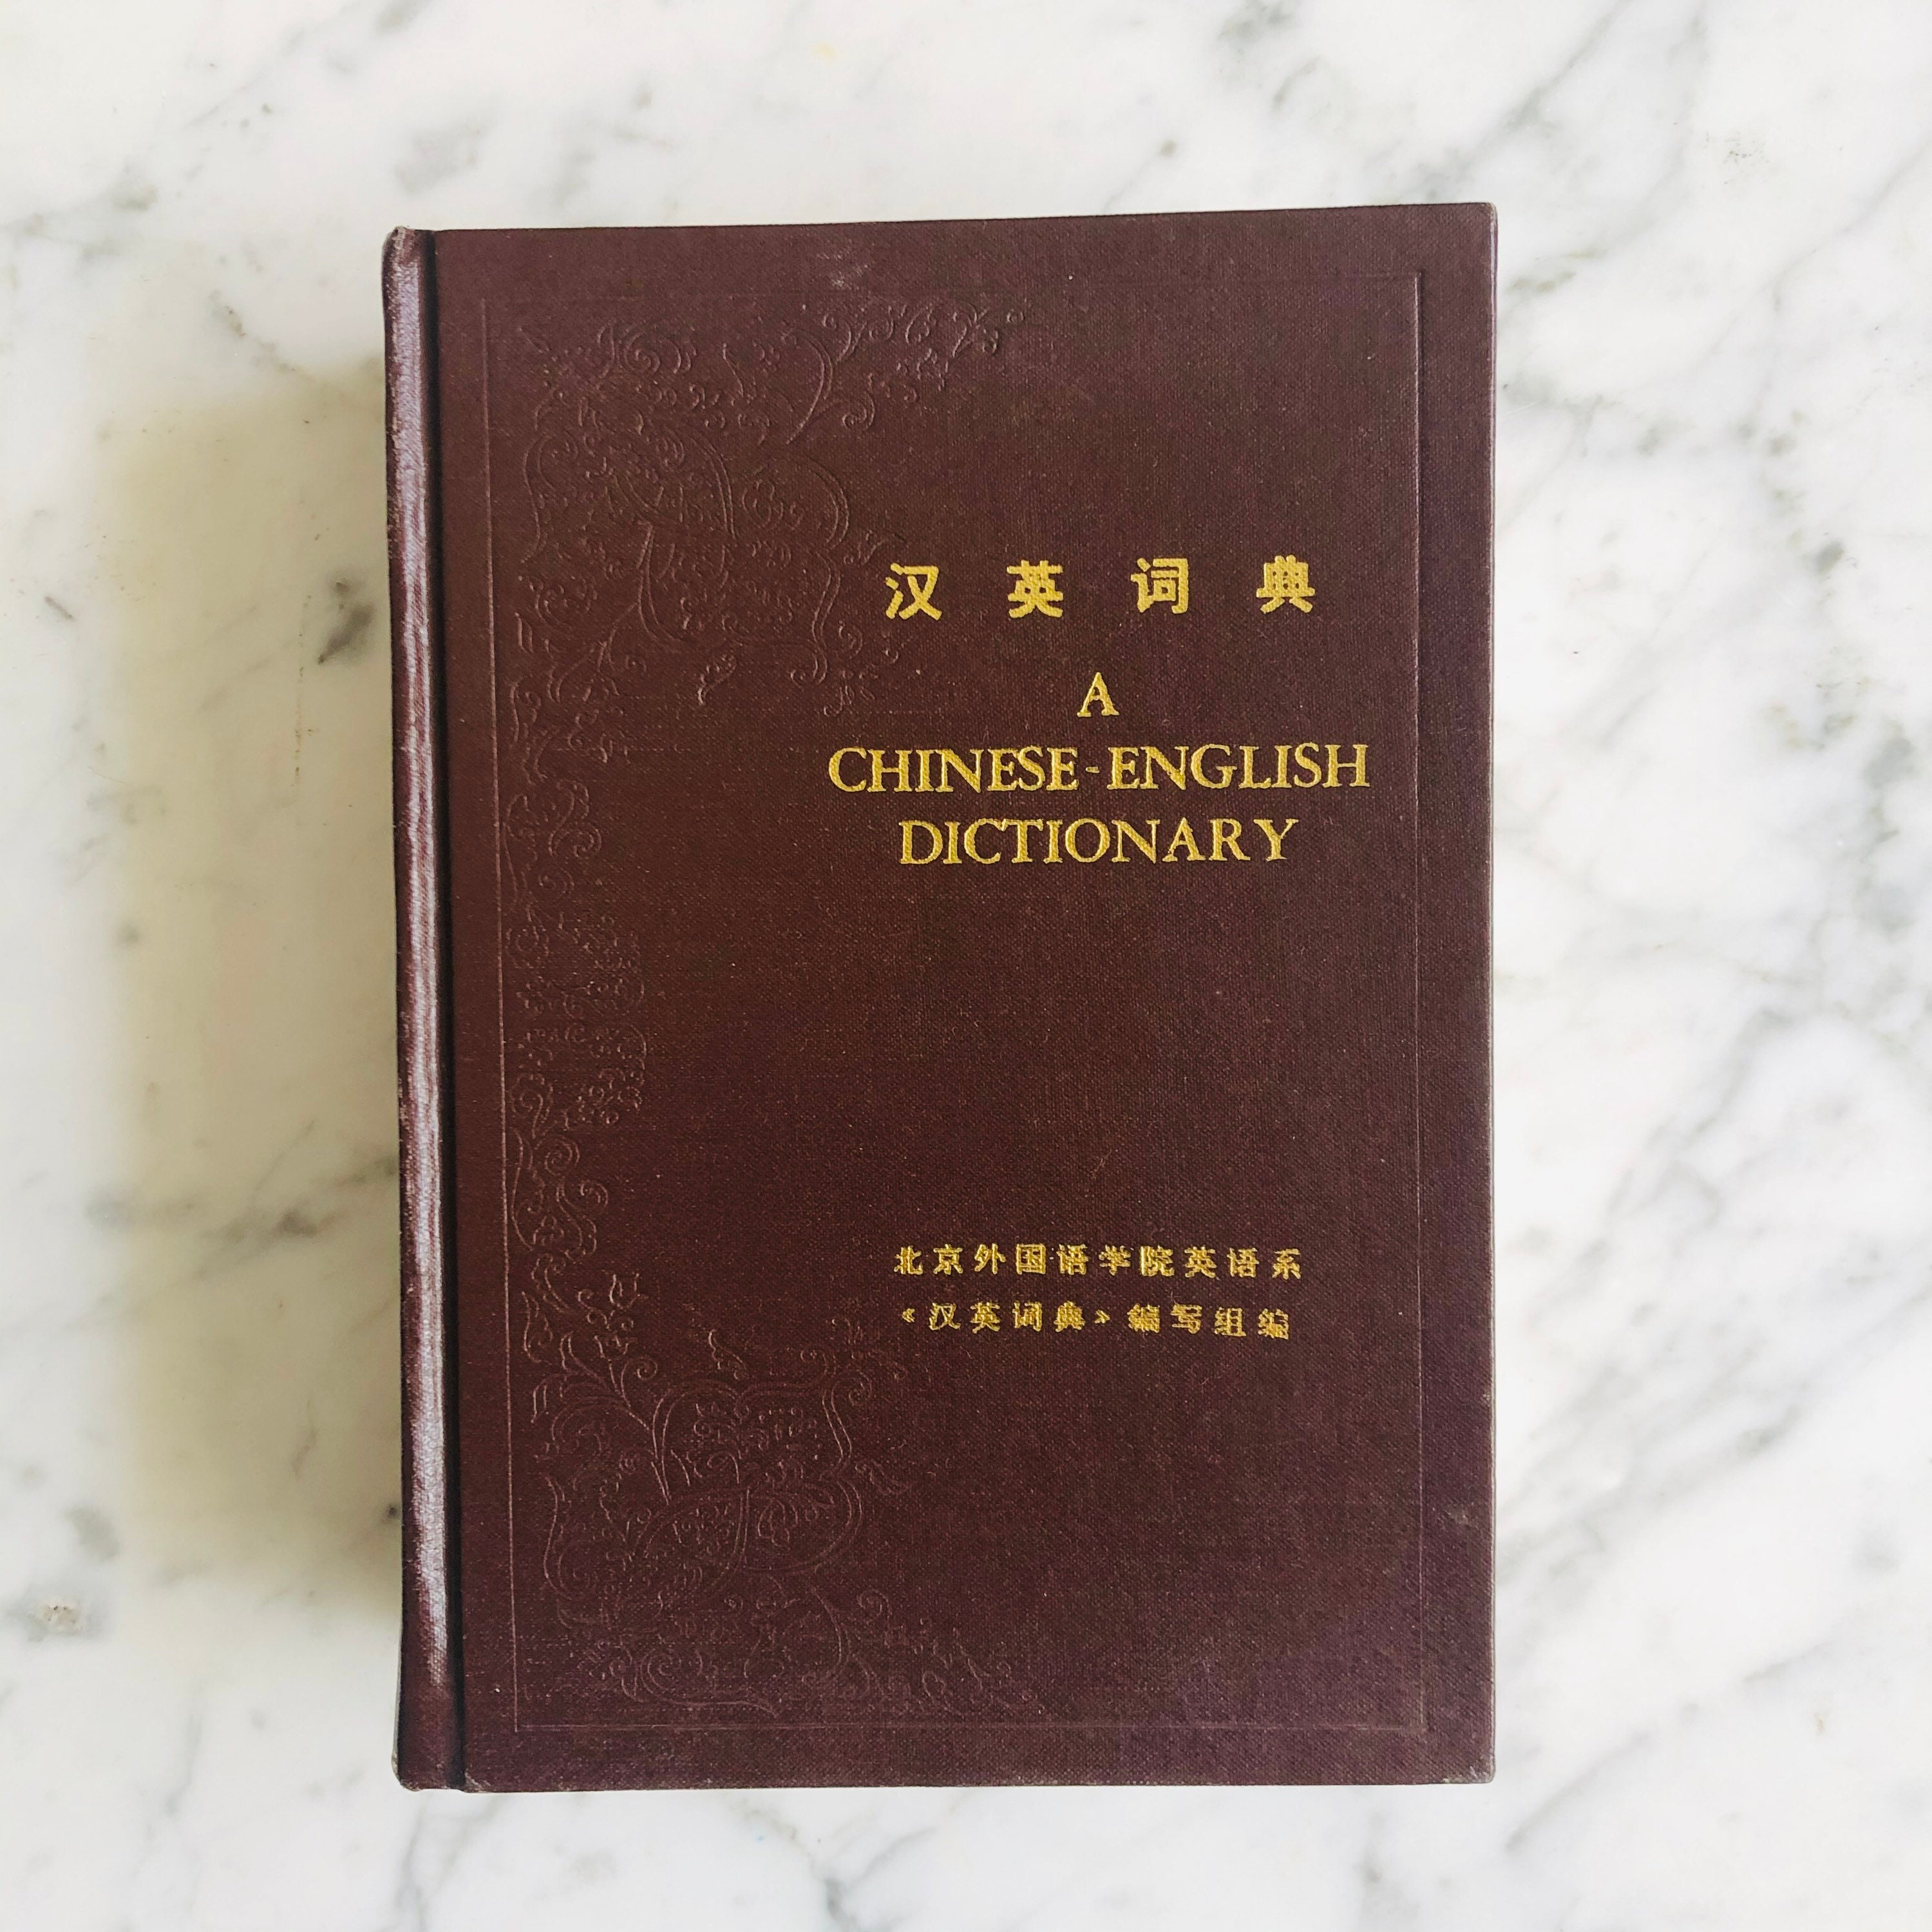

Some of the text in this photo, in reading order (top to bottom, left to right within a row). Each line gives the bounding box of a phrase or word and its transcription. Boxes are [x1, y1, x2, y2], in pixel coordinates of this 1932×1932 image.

[884, 554, 1316, 620] 汉英词典
[1077, 672, 1119, 718] A
[828, 742, 1370, 793] CHINESE-ENGLISH
[899, 817, 1299, 866] DICTIONARY
[894, 1243, 1302, 1280] 北京外国语学院英语系
